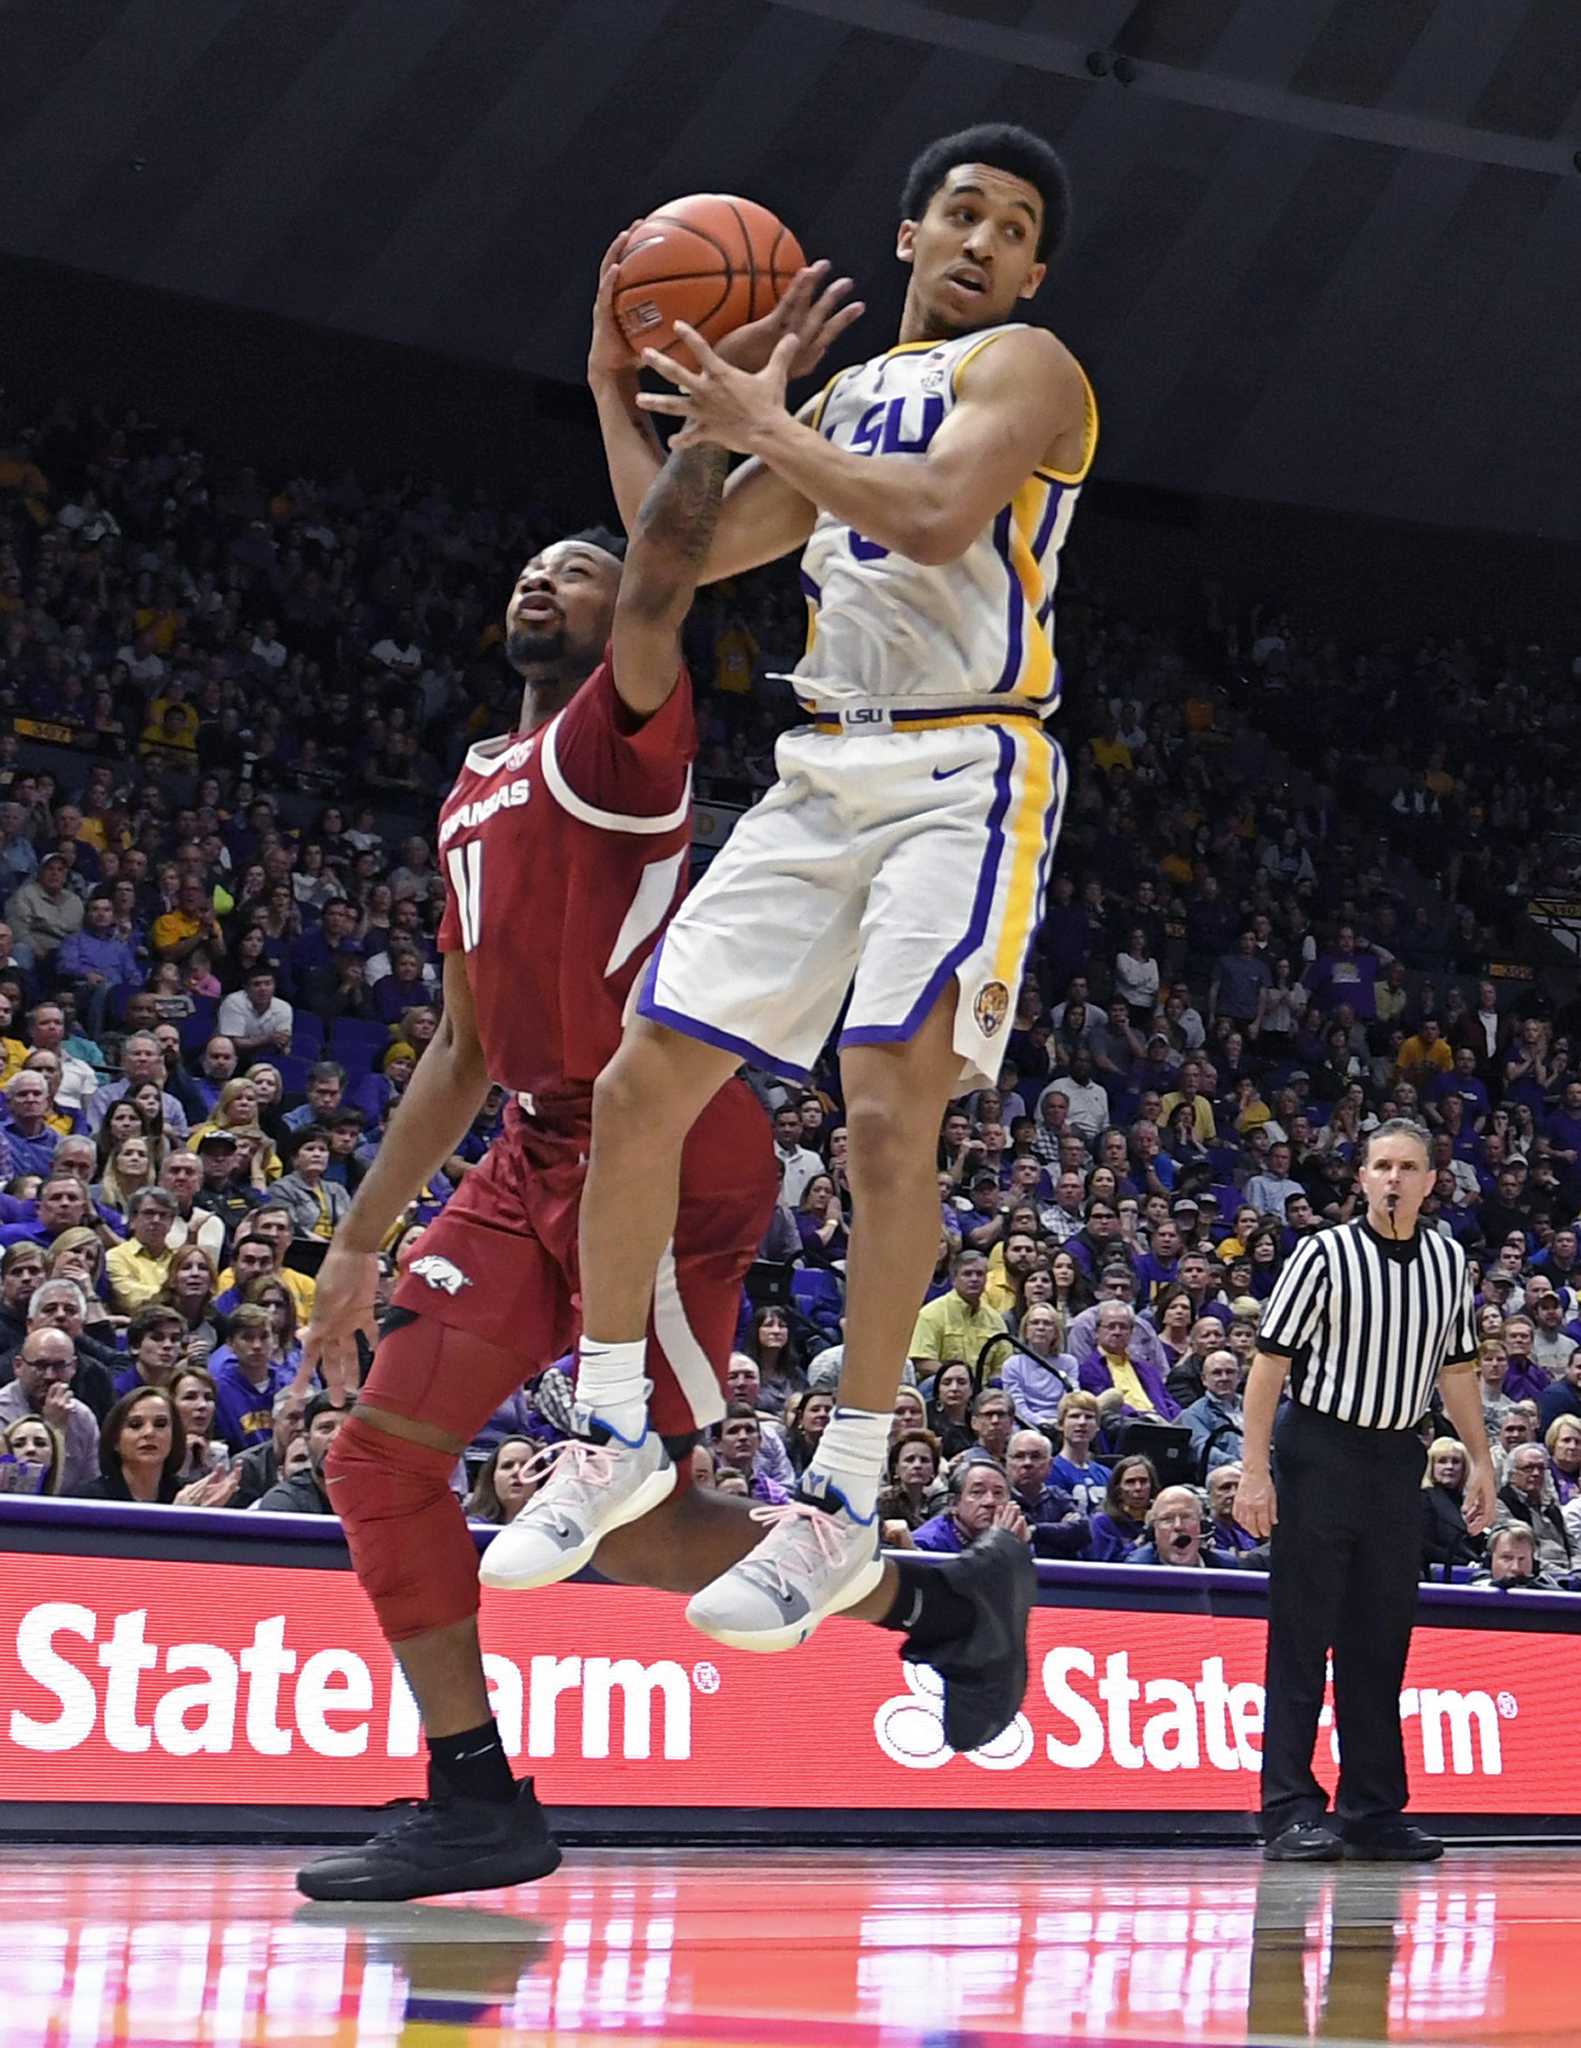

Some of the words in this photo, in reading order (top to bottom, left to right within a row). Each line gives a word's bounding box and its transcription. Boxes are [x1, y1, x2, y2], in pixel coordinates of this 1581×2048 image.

[845, 708, 883, 724] LSU
[446, 839, 482, 953] 11
[8, 1601, 373, 1757] State
[1042, 1646, 1267, 1773] State
